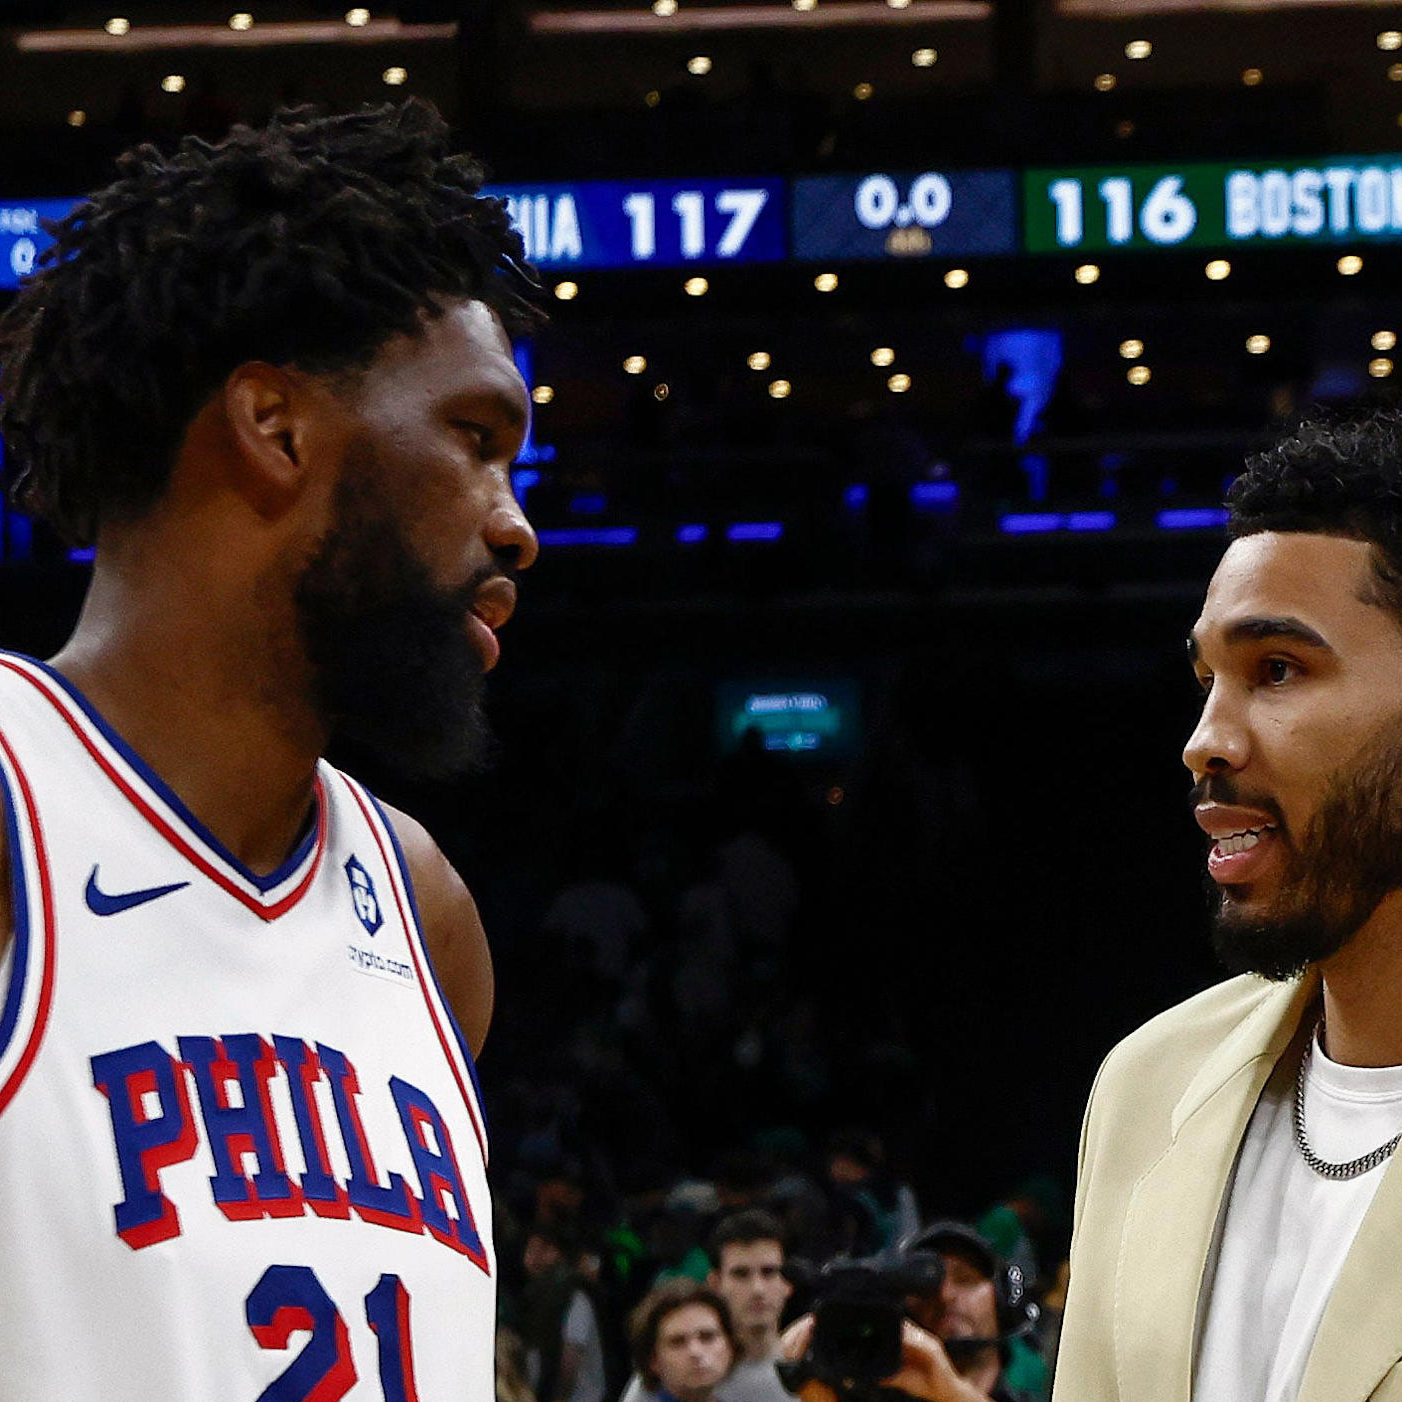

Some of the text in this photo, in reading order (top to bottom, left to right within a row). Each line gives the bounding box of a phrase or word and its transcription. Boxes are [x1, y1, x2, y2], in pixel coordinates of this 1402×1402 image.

[622, 189, 768, 260] 117
[855, 172, 952, 229] 0.0
[1049, 174, 1197, 247] 116
[91, 1034, 490, 1276] PHILA
